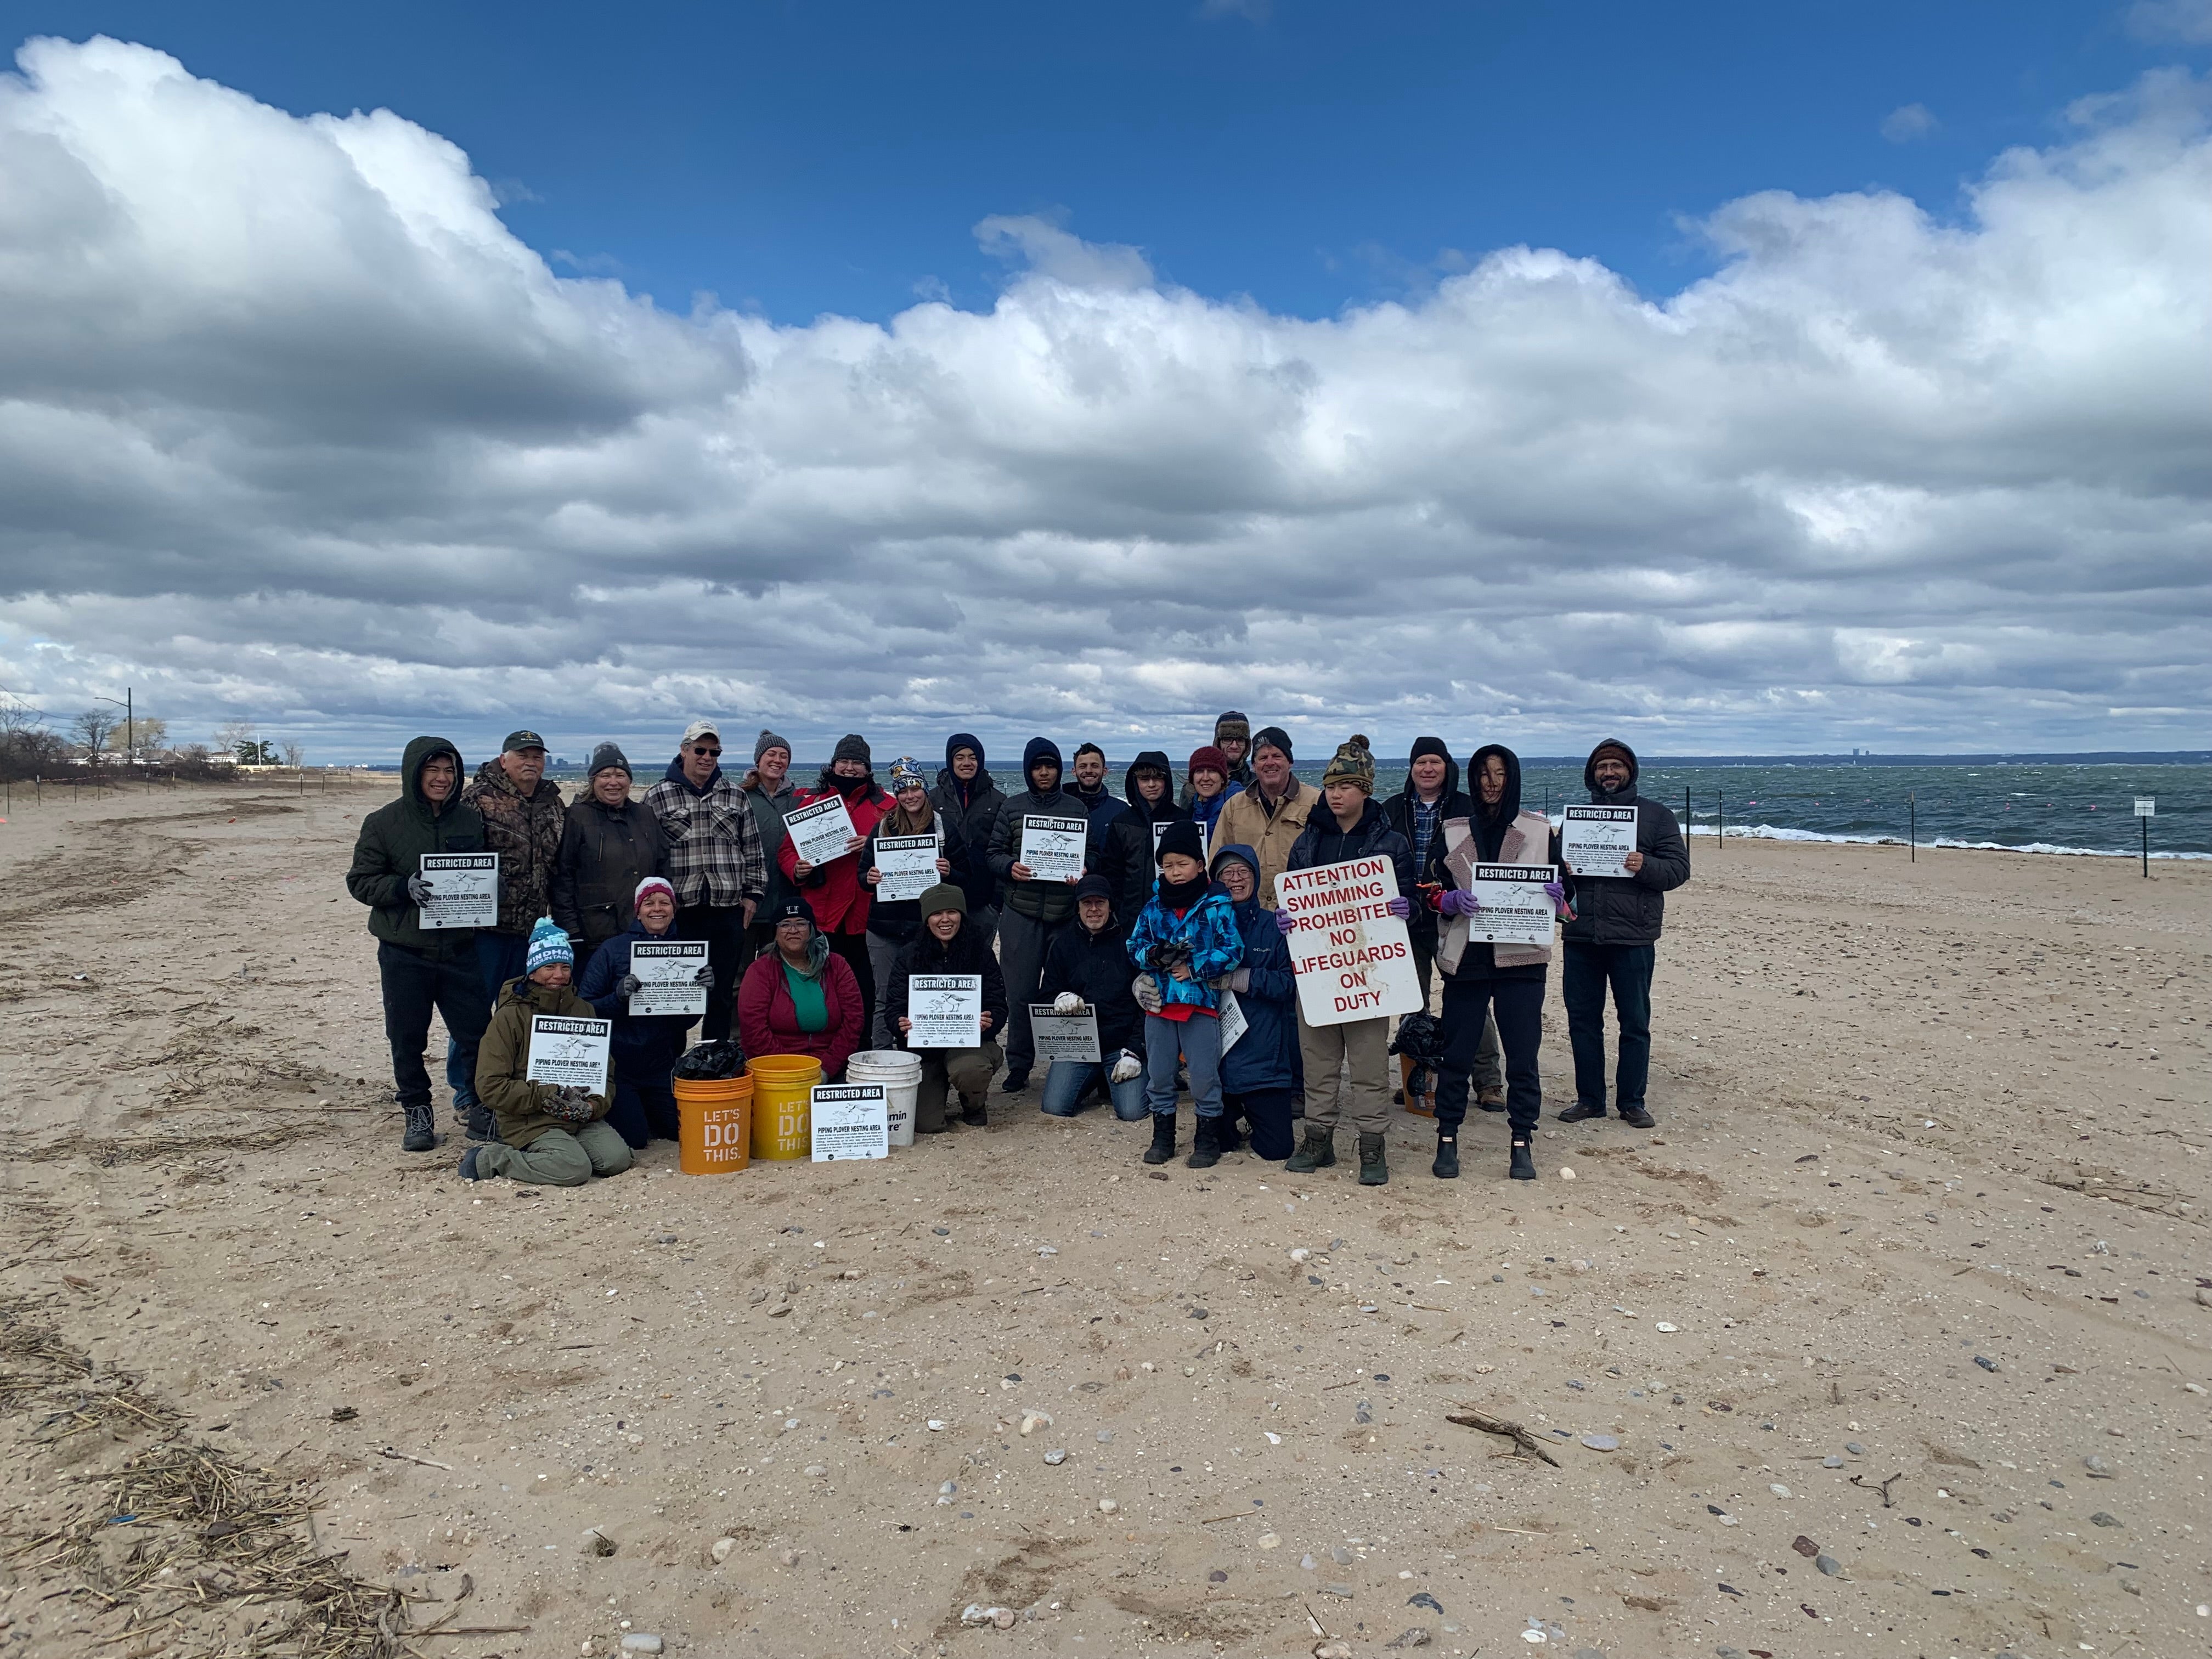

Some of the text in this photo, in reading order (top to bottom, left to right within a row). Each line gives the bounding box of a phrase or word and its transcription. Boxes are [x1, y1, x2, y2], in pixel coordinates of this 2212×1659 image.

[788, 799, 839, 823] RESTRICTED AREA
[1569, 809, 1631, 819] RESTRICTED AREA
[1028, 819, 1082, 831] RESTRICTED AREA
[799, 839, 811, 847] PIPING
[811, 834, 825, 843] PLOVER
[824, 828, 839, 838] NESTING
[879, 838, 933, 849] RESTRICTED AREA
[427, 858, 492, 868] RESTRICTED AREA
[1283, 859, 1384, 892] ATTENTION
[1479, 868, 1550, 880] RESTRICTED AREA
[1287, 882, 1384, 912] SWIMMING
[1330, 929, 1356, 946] NO
[637, 946, 702, 955] RESTRICTED AREA
[533, 955, 569, 967] MOUNTAIN
[1291, 942, 1406, 975] LIFEGUARDS
[915, 979, 975, 988] RESTRICTED AREA
[1340, 971, 1367, 989] ON
[1334, 990, 1381, 1012] DUTY
[538, 1020, 605, 1034] RESTRICTED AREA
[816, 1088, 880, 1099] RESTRICTED AREA
[704, 1108, 740, 1122] LET'S
[779, 1114, 808, 1136] DO
[704, 1123, 739, 1147] DO
[703, 1147, 741, 1162] THIS.
